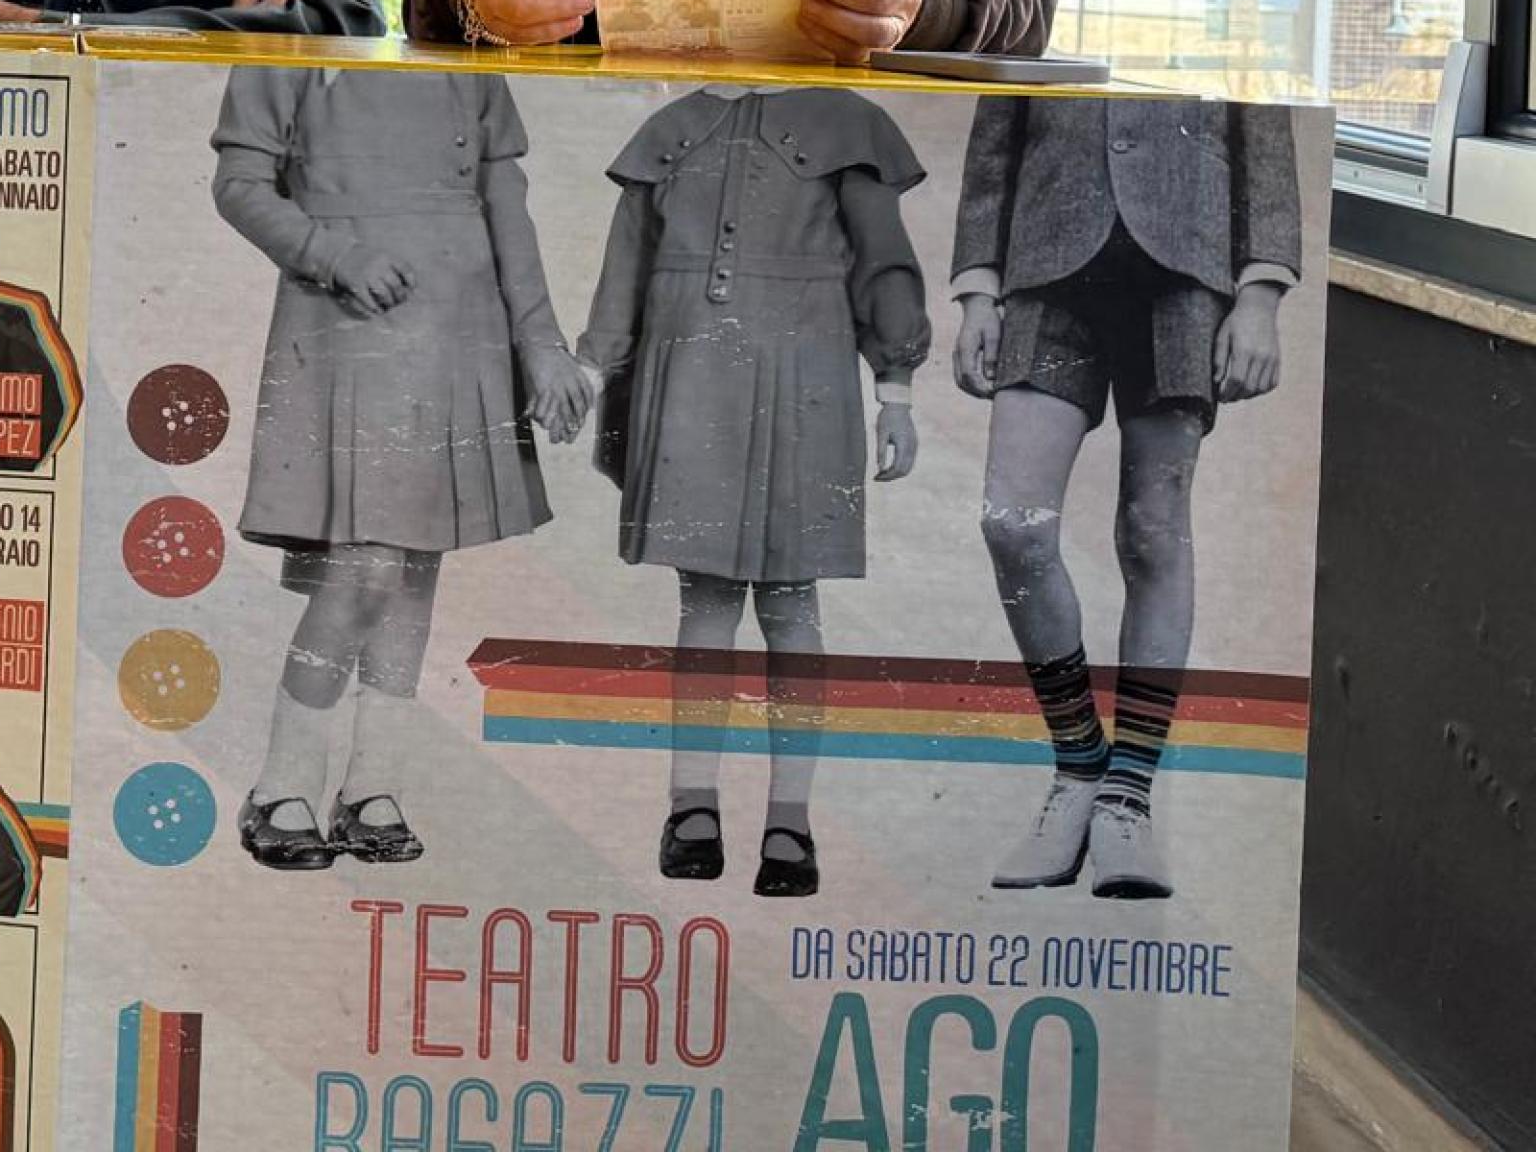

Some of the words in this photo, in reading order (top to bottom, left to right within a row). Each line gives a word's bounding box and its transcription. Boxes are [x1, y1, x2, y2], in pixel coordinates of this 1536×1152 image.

[20, 504, 41, 533] 14
[350, 900, 730, 1068] TEATRO
[792, 927, 833, 981] DA
[846, 929, 975, 985] SABATO
[988, 934, 1030, 987] 22
[1041, 936, 1233, 997] NOVEMBRE
[793, 992, 1099, 1152] AGO
